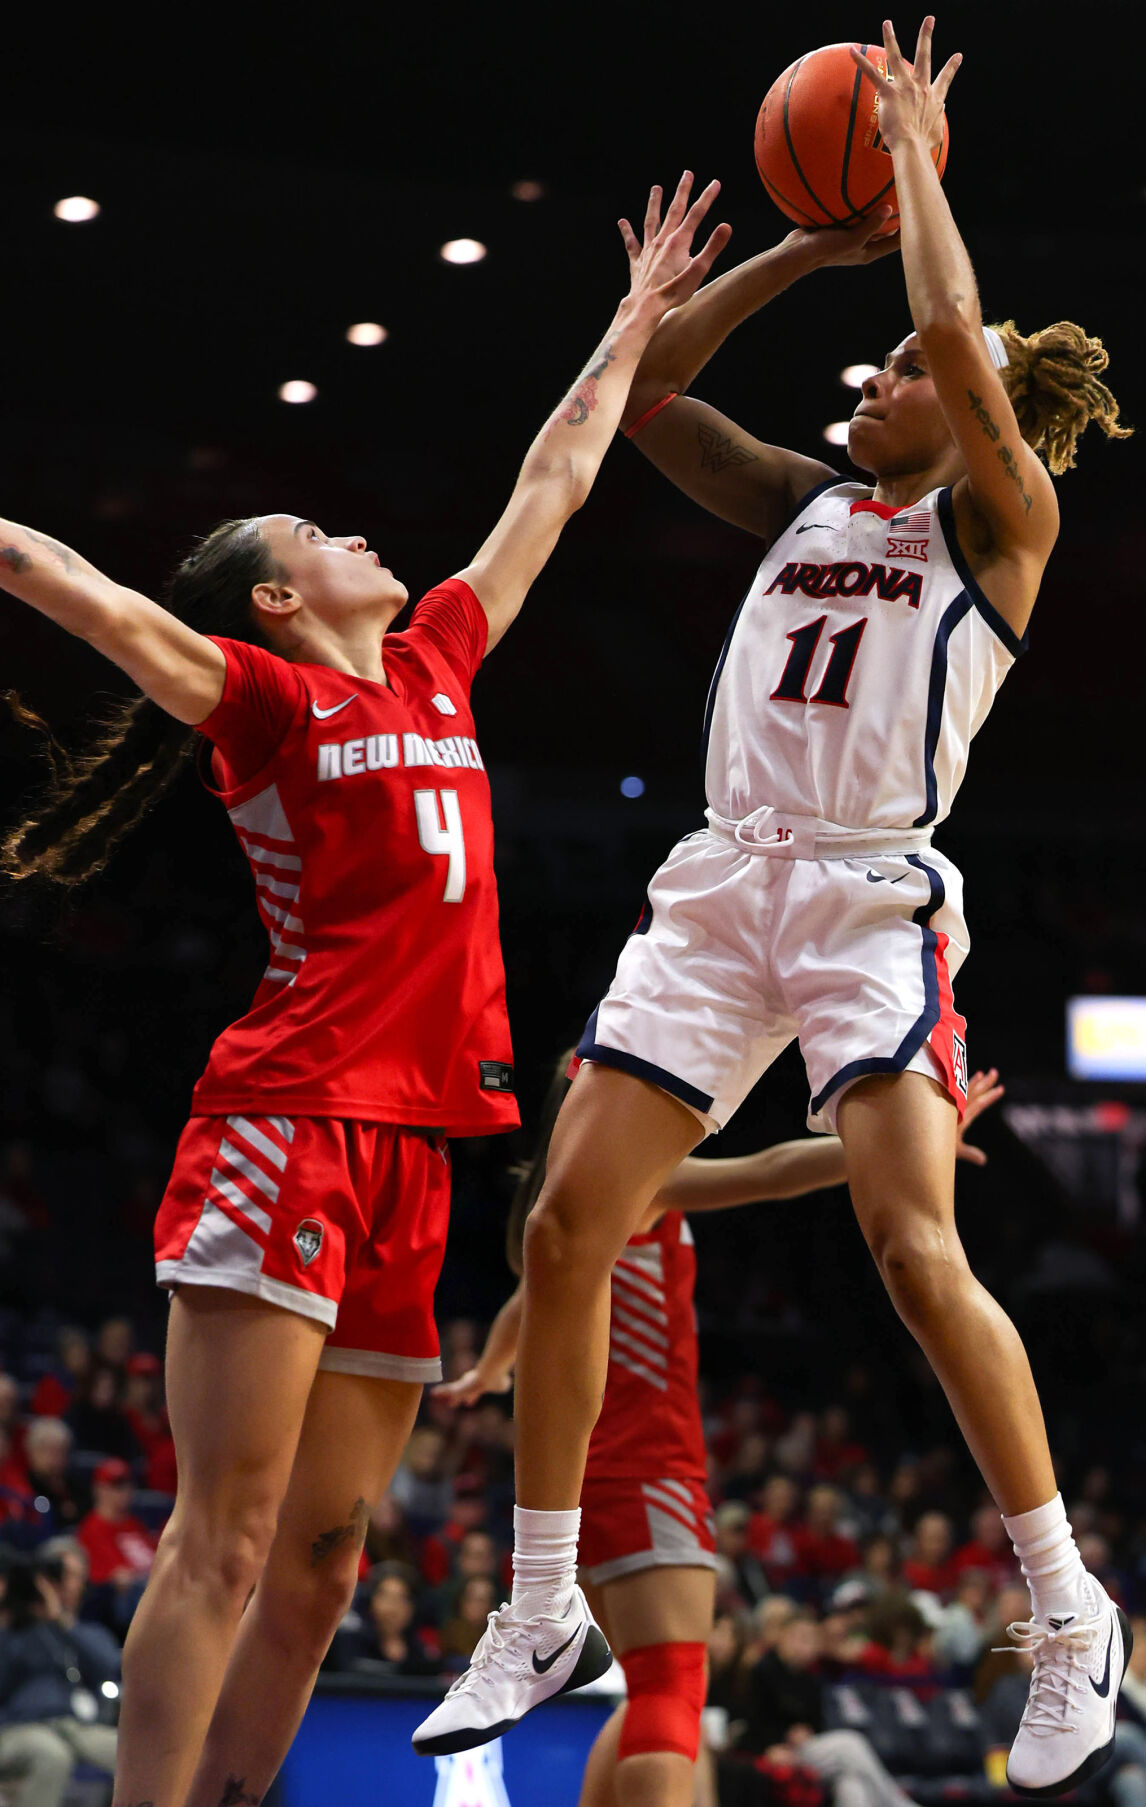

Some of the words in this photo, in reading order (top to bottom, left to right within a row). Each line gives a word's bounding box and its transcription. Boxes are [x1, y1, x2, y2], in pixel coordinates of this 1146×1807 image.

[762, 562, 924, 609] ARIZONA
[769, 615, 868, 709] 11
[318, 733, 399, 781] NEW
[413, 789, 466, 903] 4
